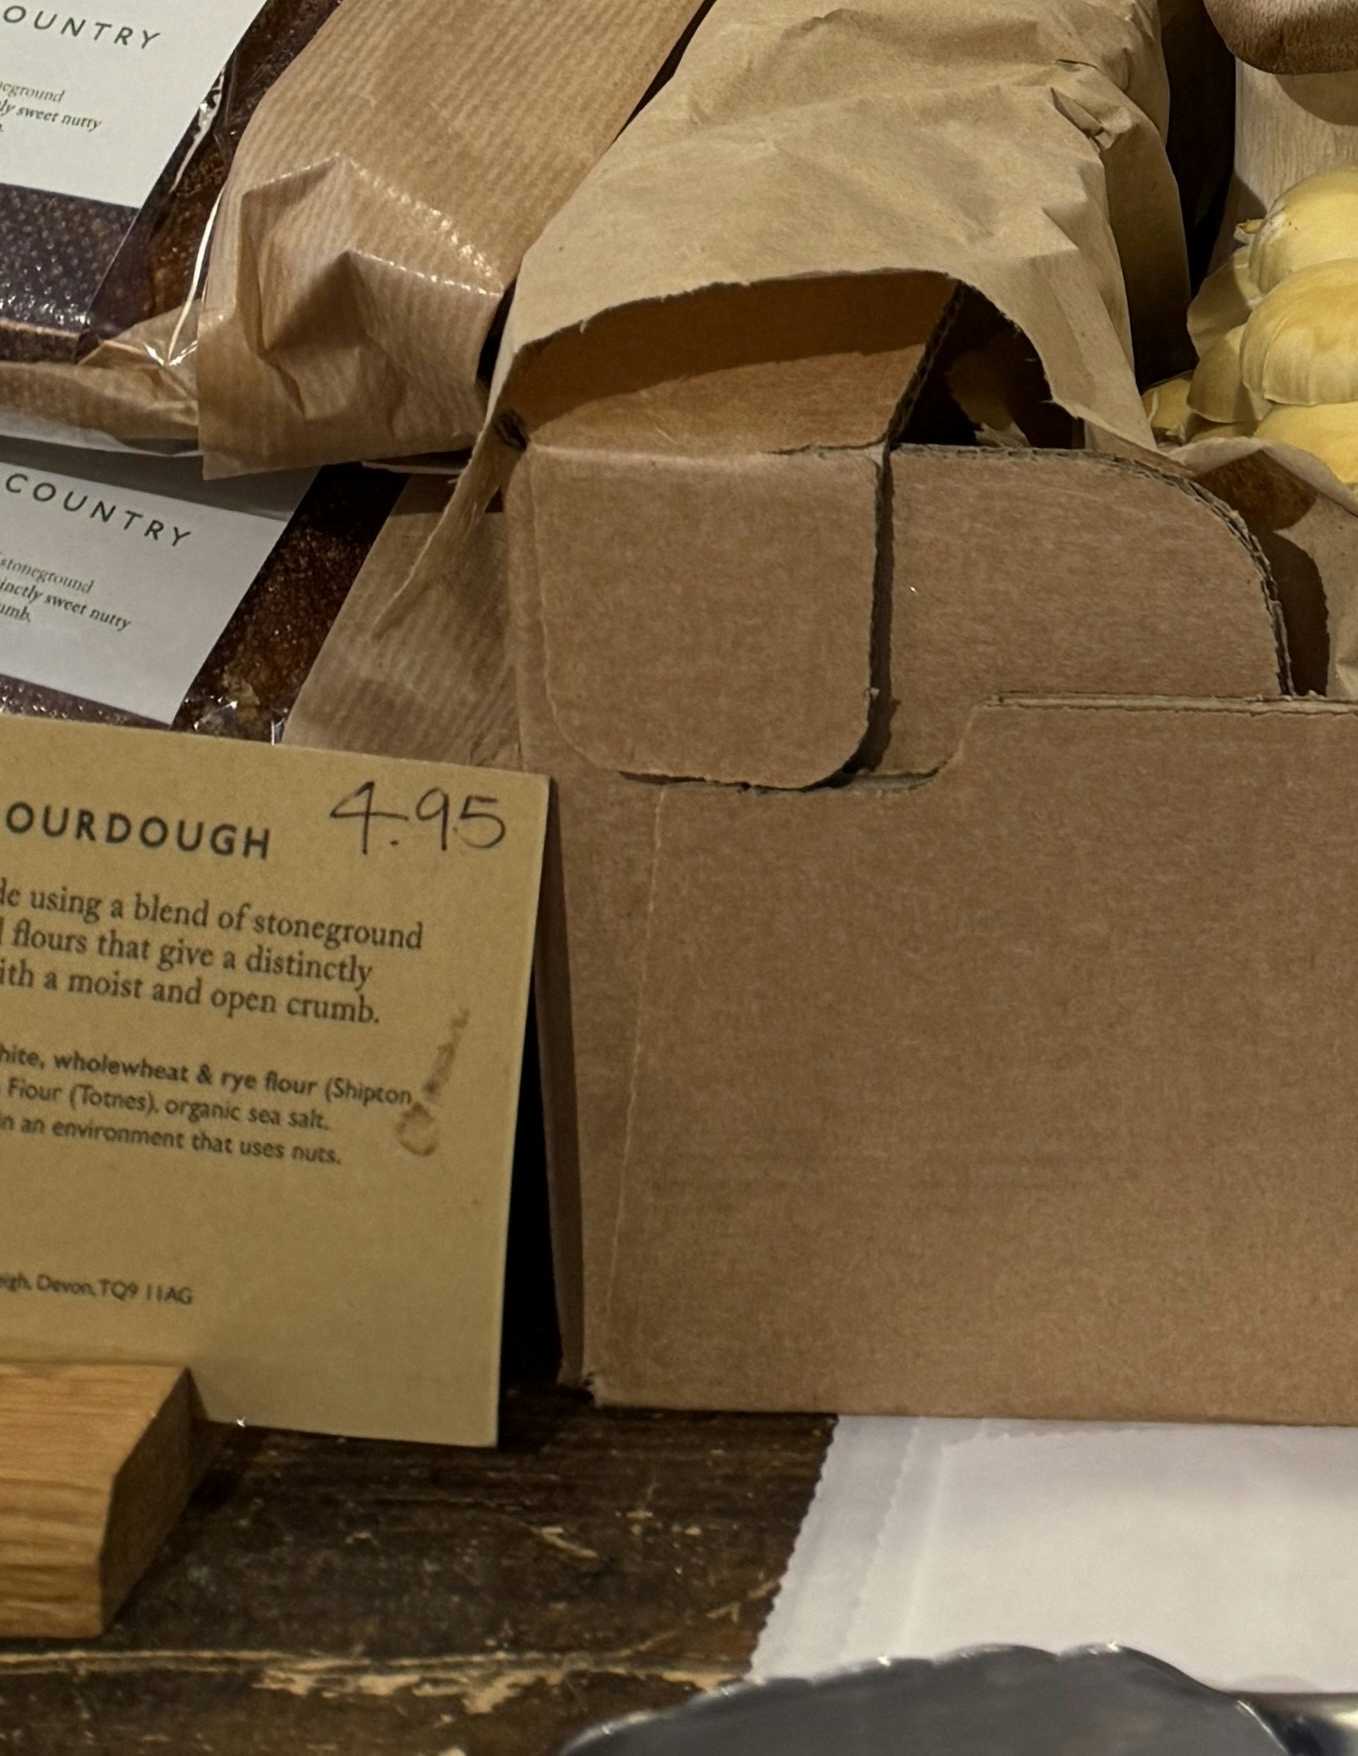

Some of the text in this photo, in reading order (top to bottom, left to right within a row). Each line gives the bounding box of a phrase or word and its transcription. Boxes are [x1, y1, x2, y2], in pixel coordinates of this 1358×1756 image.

[2, 4, 162, 50] OUNTRY
[16, 105, 103, 133] sweet nutty
[5, 473, 192, 548] COUNTRY
[0, 556, 95, 595] stoneground
[44, 593, 132, 633] sweet nutty
[6, 780, 508, 861] OURDOUGH 4.95
[30, 886, 424, 954] using a blend of stoneground
[12, 919, 373, 992] flours that give a distinctly
[44, 967, 381, 1025] a moist and open crumb.
[7, 1076, 63, 1103] Flour
[165, 1097, 240, 1123] organic
[247, 1107, 281, 1127] sea
[54, 1050, 189, 1085] wholewheat
[196, 1063, 211, 1086] &
[220, 1071, 258, 1095] rye
[265, 1070, 318, 1096] flour
[324, 1076, 413, 1108] (Shipton
[21, 1118, 341, 1166] an environment that uses nuts.
